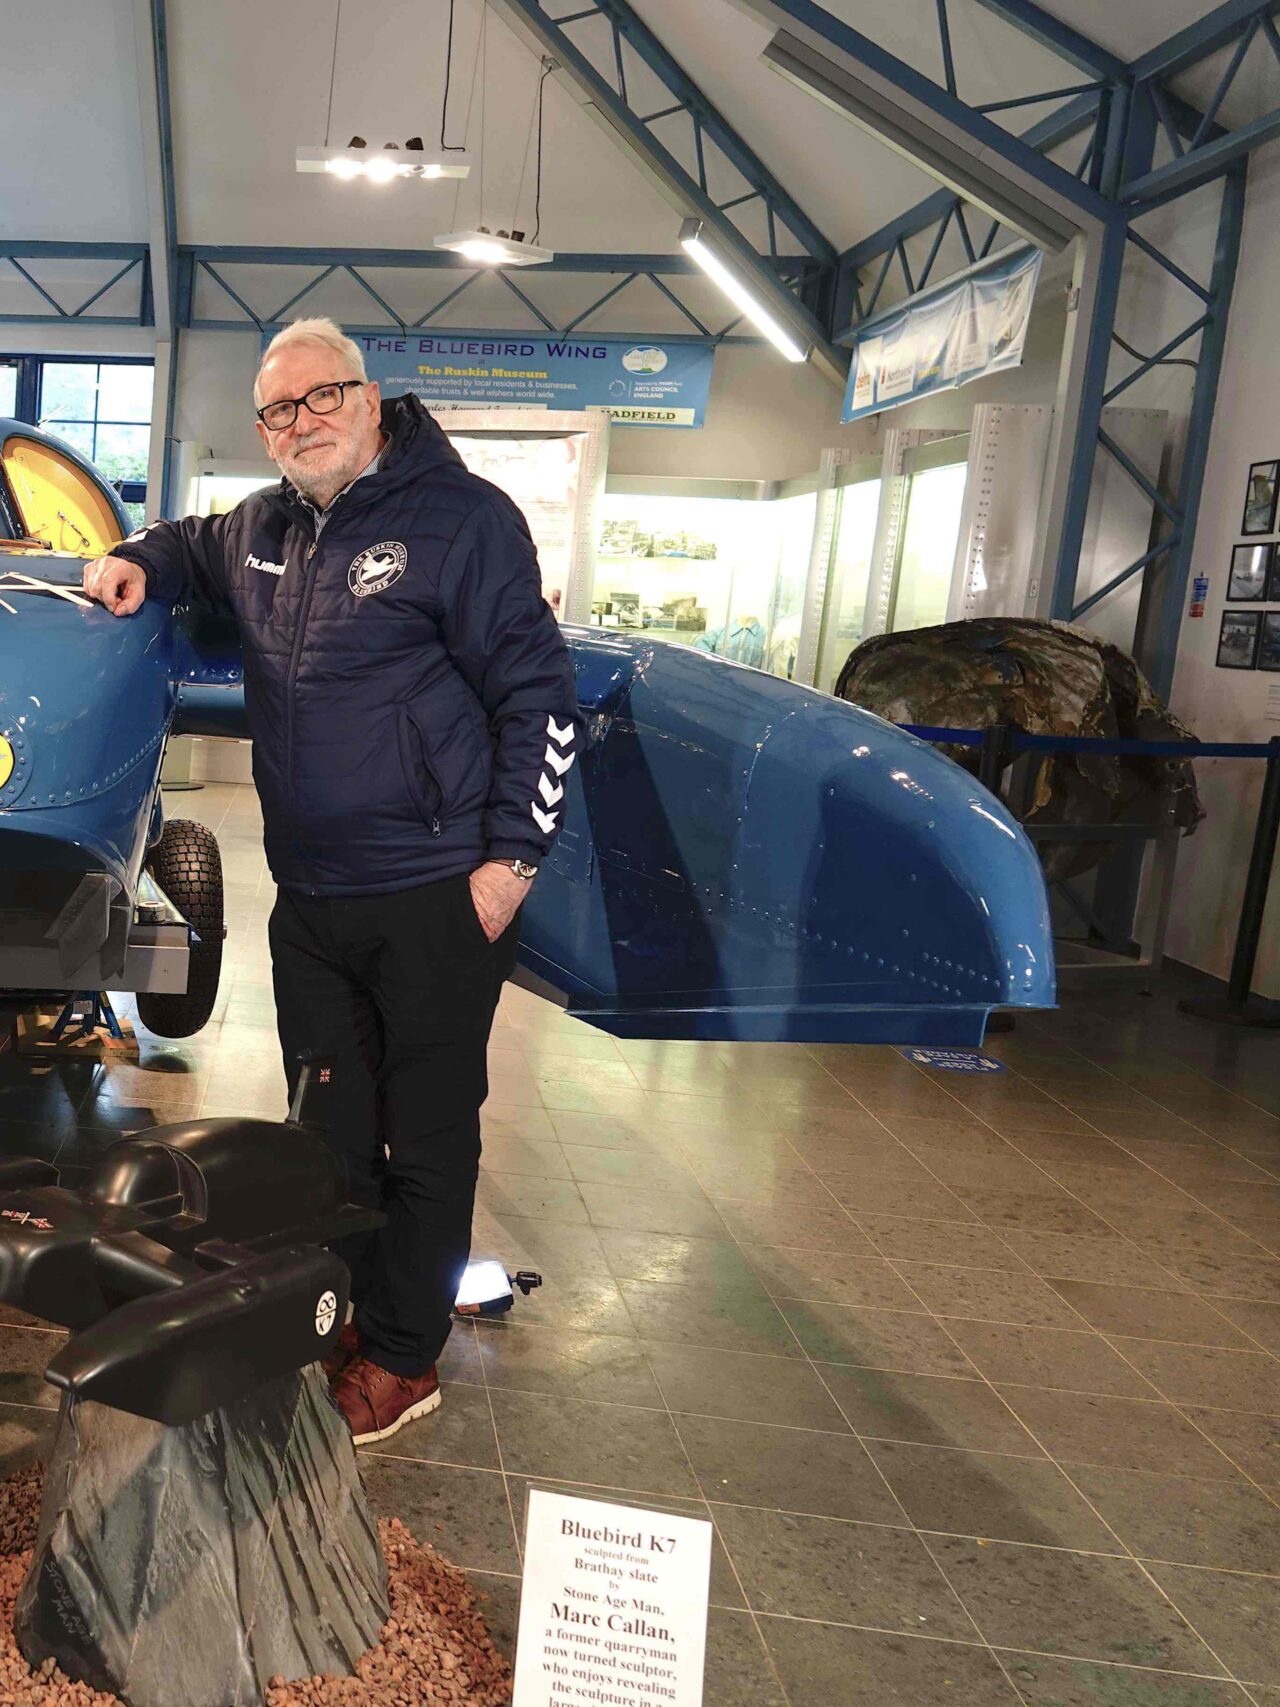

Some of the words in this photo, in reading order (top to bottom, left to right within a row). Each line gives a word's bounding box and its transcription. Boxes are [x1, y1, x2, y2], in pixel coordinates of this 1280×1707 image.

[385, 376, 424, 386] generously
[426, 378, 461, 387] supported
[463, 379, 473, 388] by
[492, 380, 526, 388] residents
[417, 365, 441, 375] The
[444, 366, 489, 377] Ruskin
[491, 368, 548, 379] Museum
[405, 387, 439, 395] charitable
[441, 387, 464, 395] trusts
[486, 389, 514, 397] wishers
[600, 410, 676, 420] ADFIELD
[319, 1314, 331, 1332] K7
[561, 1518, 642, 1549] Bluebird
[650, 1535, 677, 1554] K7
[584, 1546, 623, 1561] sculpted
[625, 1550, 650, 1566] from
[574, 1557, 624, 1578] Brathay
[629, 1568, 659, 1584] slate
[609, 1580, 620, 1591] by
[563, 1586, 599, 1603] Stone
[603, 1595, 627, 1610] Age
[632, 1598, 665, 1616] Man,
[550, 1602, 601, 1627] Marc
[607, 1613, 676, 1644] Callan,
[545, 1628, 553, 1637] a
[557, 1628, 601, 1647] former
[604, 1639, 678, 1662] quarryman
[544, 1645, 569, 1657] now
[574, 1650, 617, 1668] turned
[620, 1661, 677, 1681] sculptor,
[542, 1662, 569, 1676] who
[572, 1668, 613, 1686] enjoys
[617, 1677, 676, 1700] revealing
[552, 1680, 573, 1694] the
[575, 1686, 636, 1707] sculpture
[639, 1697, 651, 1707] in
